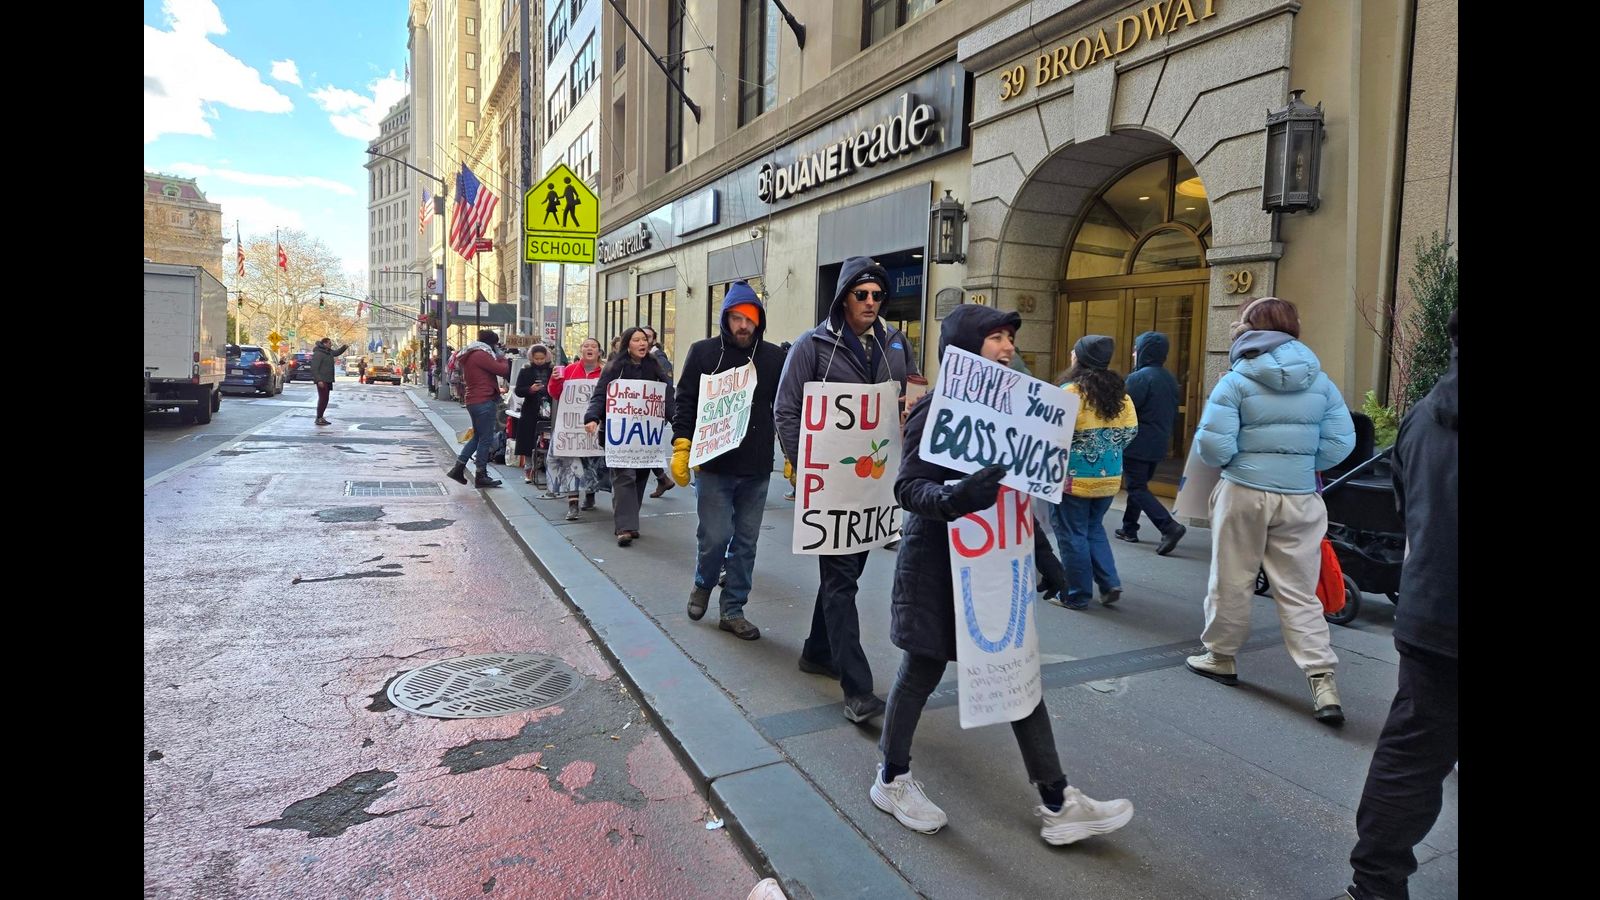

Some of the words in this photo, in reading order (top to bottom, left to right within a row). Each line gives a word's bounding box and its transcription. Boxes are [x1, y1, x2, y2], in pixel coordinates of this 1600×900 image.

[1000, 65, 1026, 101] 39
[530, 240, 591, 256] SCHOOL
[1225, 270, 1253, 295] 39
[565, 384, 596, 405] US
[607, 383, 640, 399] Unfair
[643, 384, 663, 401] Labor
[706, 368, 750, 400] USU
[943, 352, 1020, 415] HONK
[1029, 382, 1042, 396] IF
[606, 399, 642, 415] Practice
[701, 389, 747, 424] SAYS
[804, 392, 881, 431] USU
[1026, 396, 1066, 427] YOUR
[607, 418, 664, 446] UAW
[699, 415, 733, 440] TICK
[930, 409, 998, 468] BOSS
[999, 427, 1068, 484] SUCKS
[801, 505, 902, 551] STRIKE
